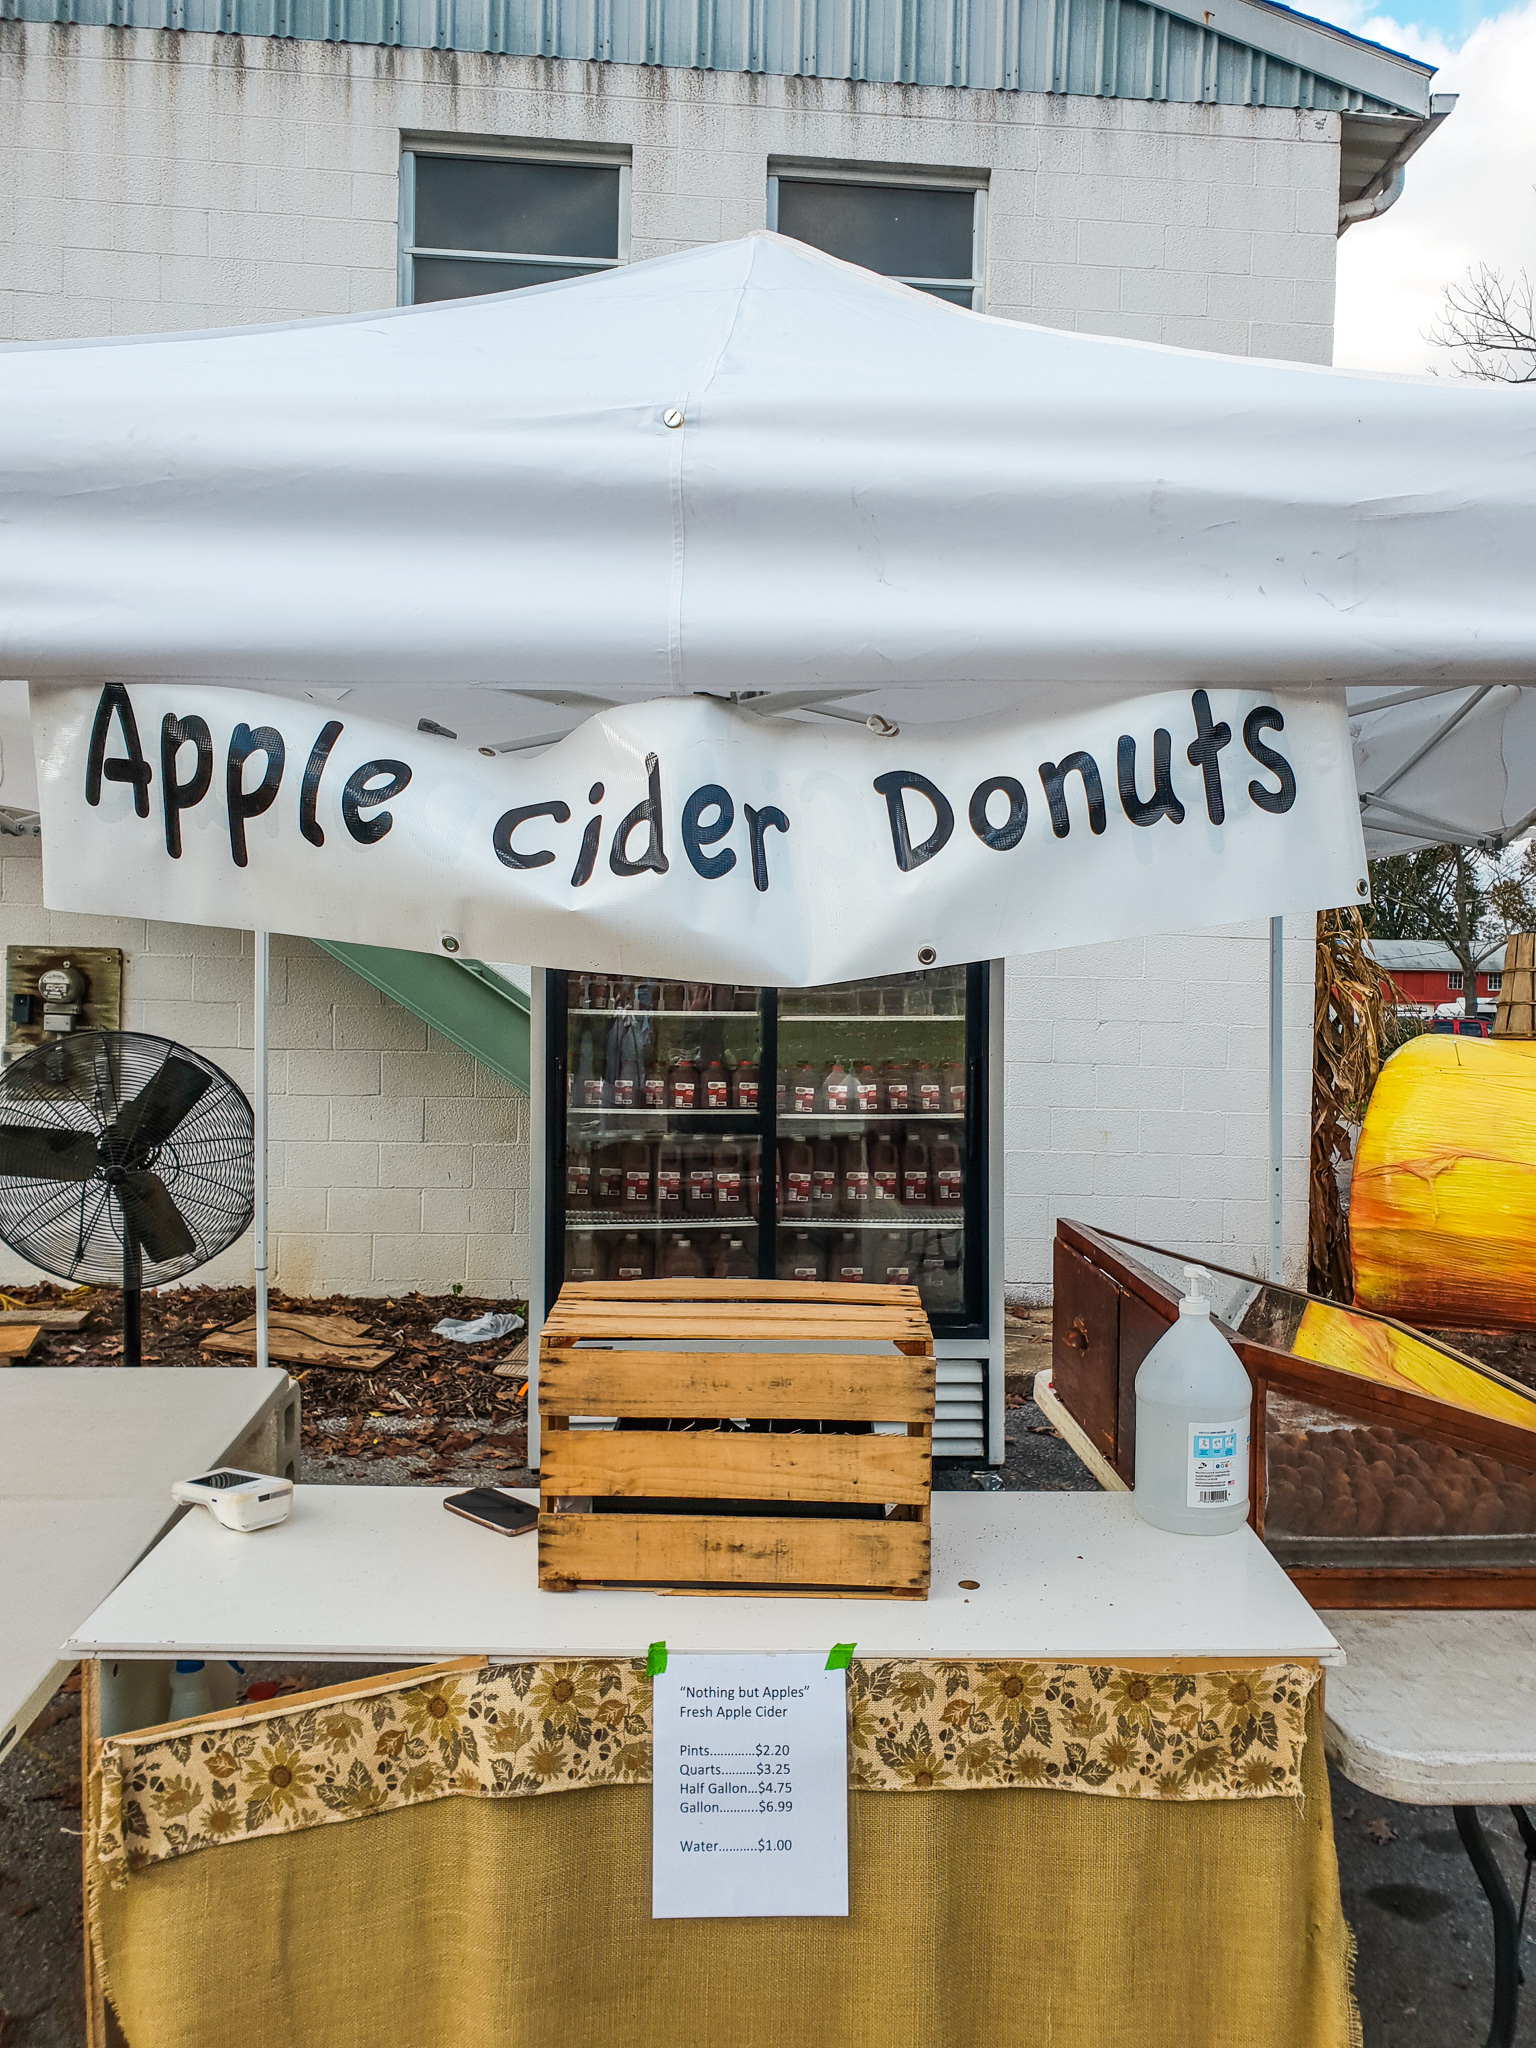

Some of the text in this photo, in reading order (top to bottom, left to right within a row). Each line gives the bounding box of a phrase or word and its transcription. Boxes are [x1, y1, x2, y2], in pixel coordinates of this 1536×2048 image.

[85, 682, 1298, 892] Apple cider Donuts
[738, 1685, 760, 1698] but
[679, 1706, 788, 1721] Fresh Apple Cider
[679, 1782, 705, 1795] Half
